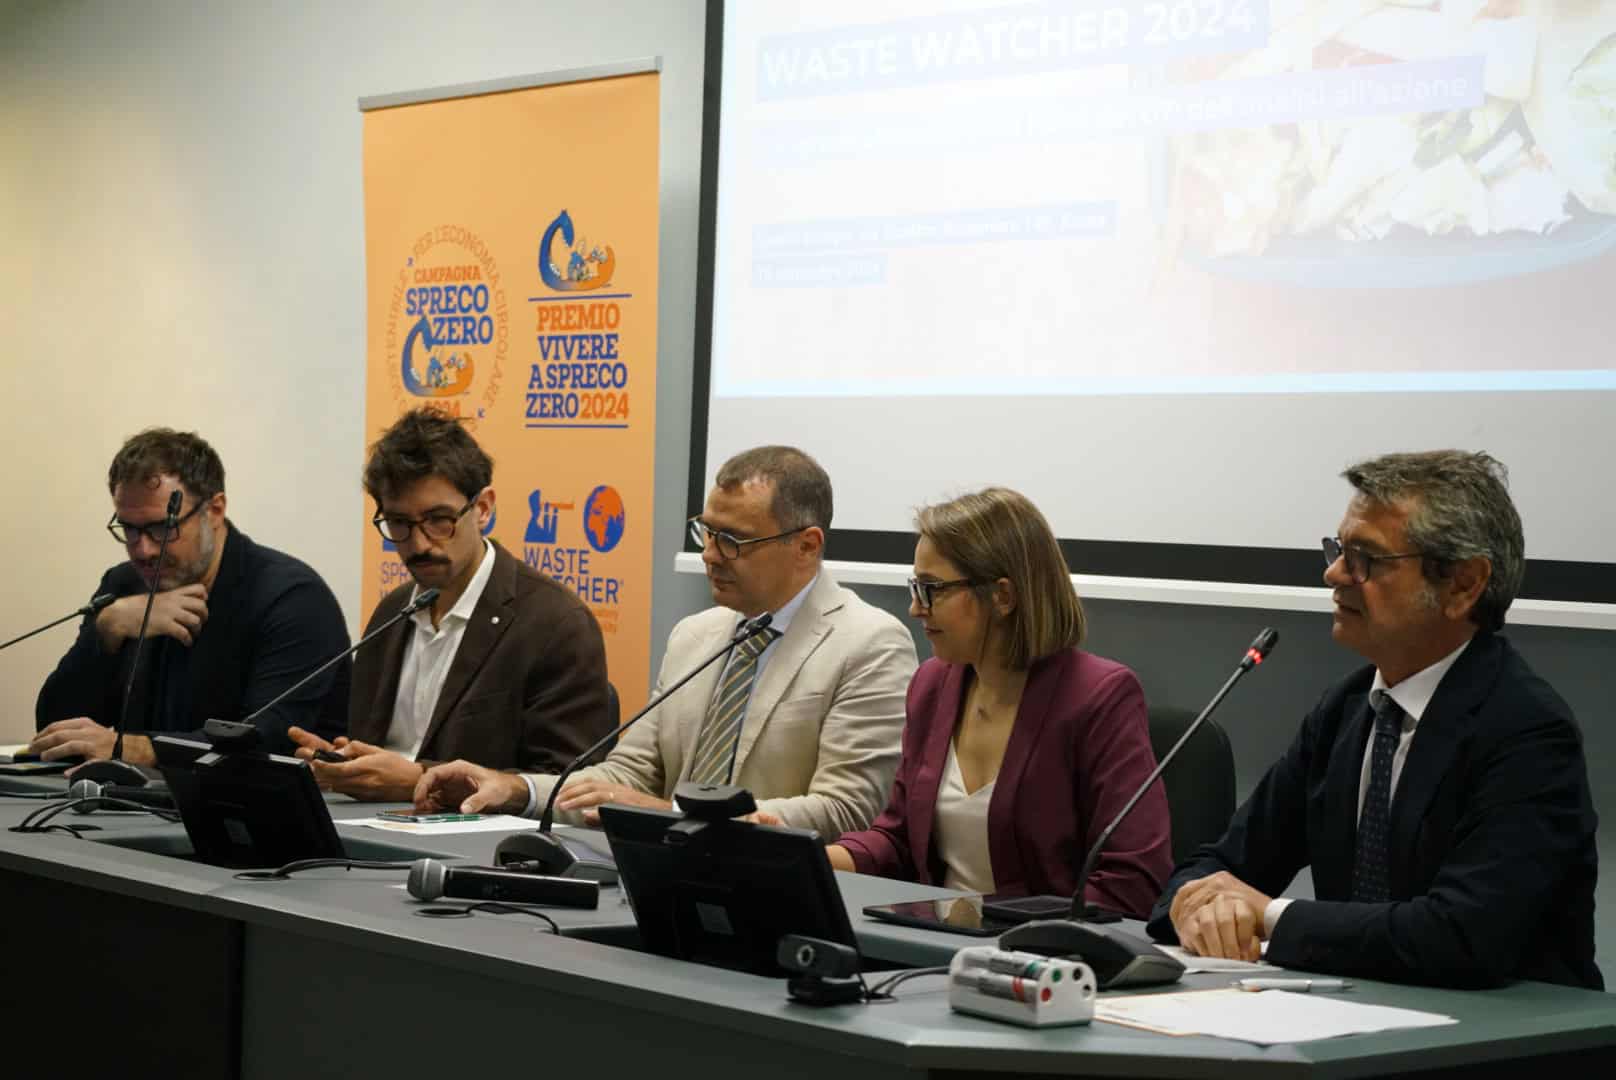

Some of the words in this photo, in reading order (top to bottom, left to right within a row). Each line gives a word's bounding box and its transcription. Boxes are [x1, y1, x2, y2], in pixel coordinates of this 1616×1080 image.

[763, 35, 898, 87] WASTE
[911, 8, 1129, 68] WATCHER
[1143, 0, 1256, 45] 2024
[414, 265, 481, 284] CAMPAGNA
[405, 283, 489, 315] SPRECO
[431, 315, 494, 346] ZERO
[536, 303, 620, 331] PREMIO
[537, 333, 619, 361] VIVERE
[528, 364, 547, 389] A
[547, 363, 628, 389] SPRECO
[525, 393, 579, 419] ZERO
[580, 392, 629, 419] 2024
[523, 546, 591, 575] WASTE
